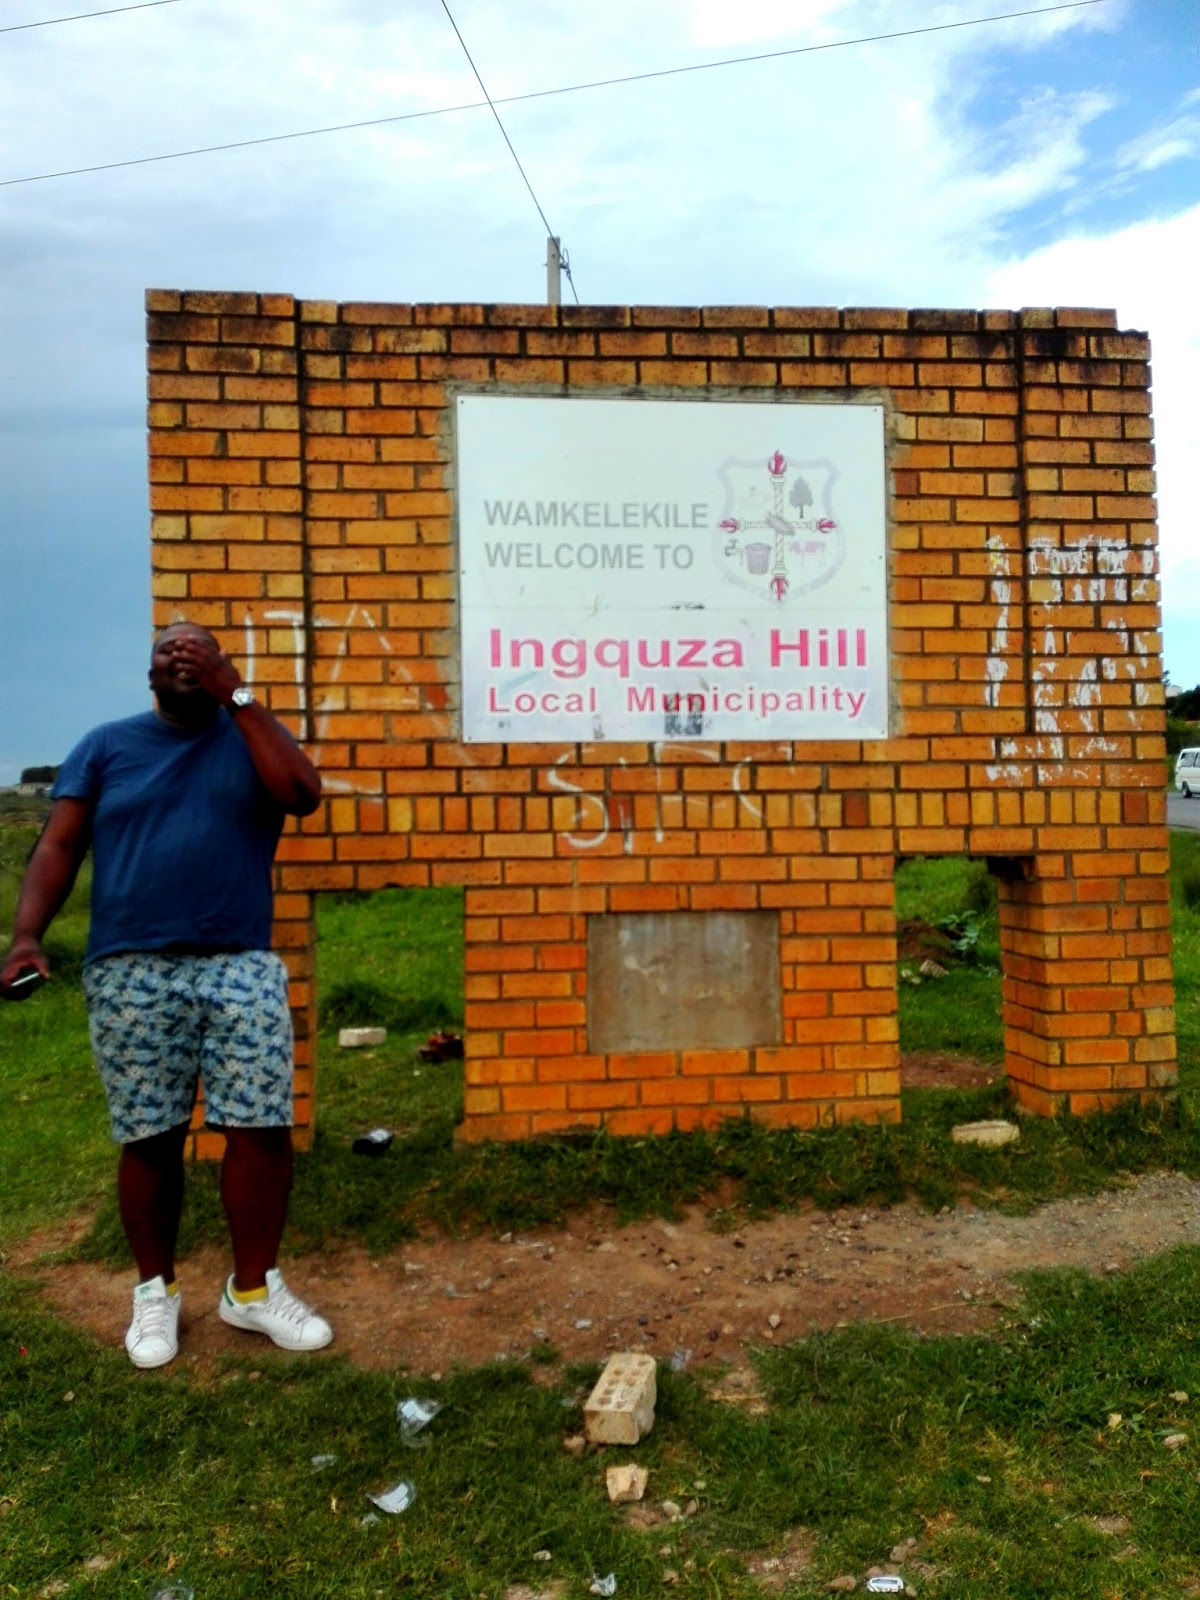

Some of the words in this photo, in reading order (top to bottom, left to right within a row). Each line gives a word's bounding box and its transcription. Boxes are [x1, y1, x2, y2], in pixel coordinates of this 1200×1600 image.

[483, 499, 709, 529] WAMKELEKILE
[483, 541, 645, 569] WELCOME
[653, 543, 695, 570] TO
[489, 628, 744, 679] Ingquza
[770, 629, 868, 668] Hill
[489, 687, 596, 713] Local
[628, 687, 866, 718] Municipality
